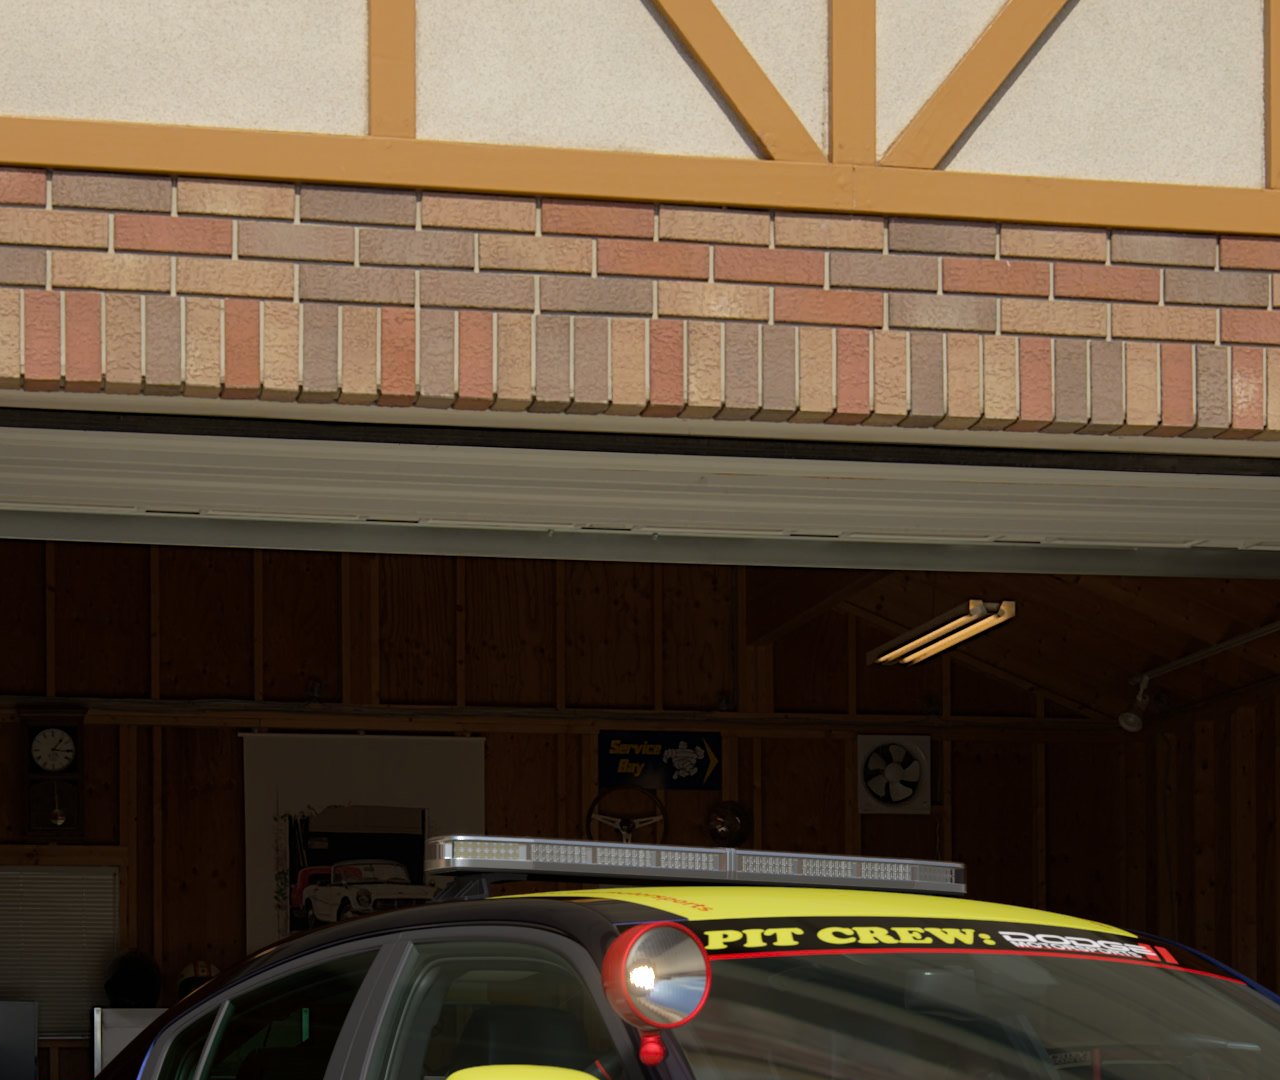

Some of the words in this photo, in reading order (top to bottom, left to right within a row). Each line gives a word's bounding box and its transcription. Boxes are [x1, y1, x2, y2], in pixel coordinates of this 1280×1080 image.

[608, 739, 662, 756] Service
[703, 927, 804, 950] PIT
[817, 926, 996, 946] CREW:
[998, 931, 1158, 957] DODGE
